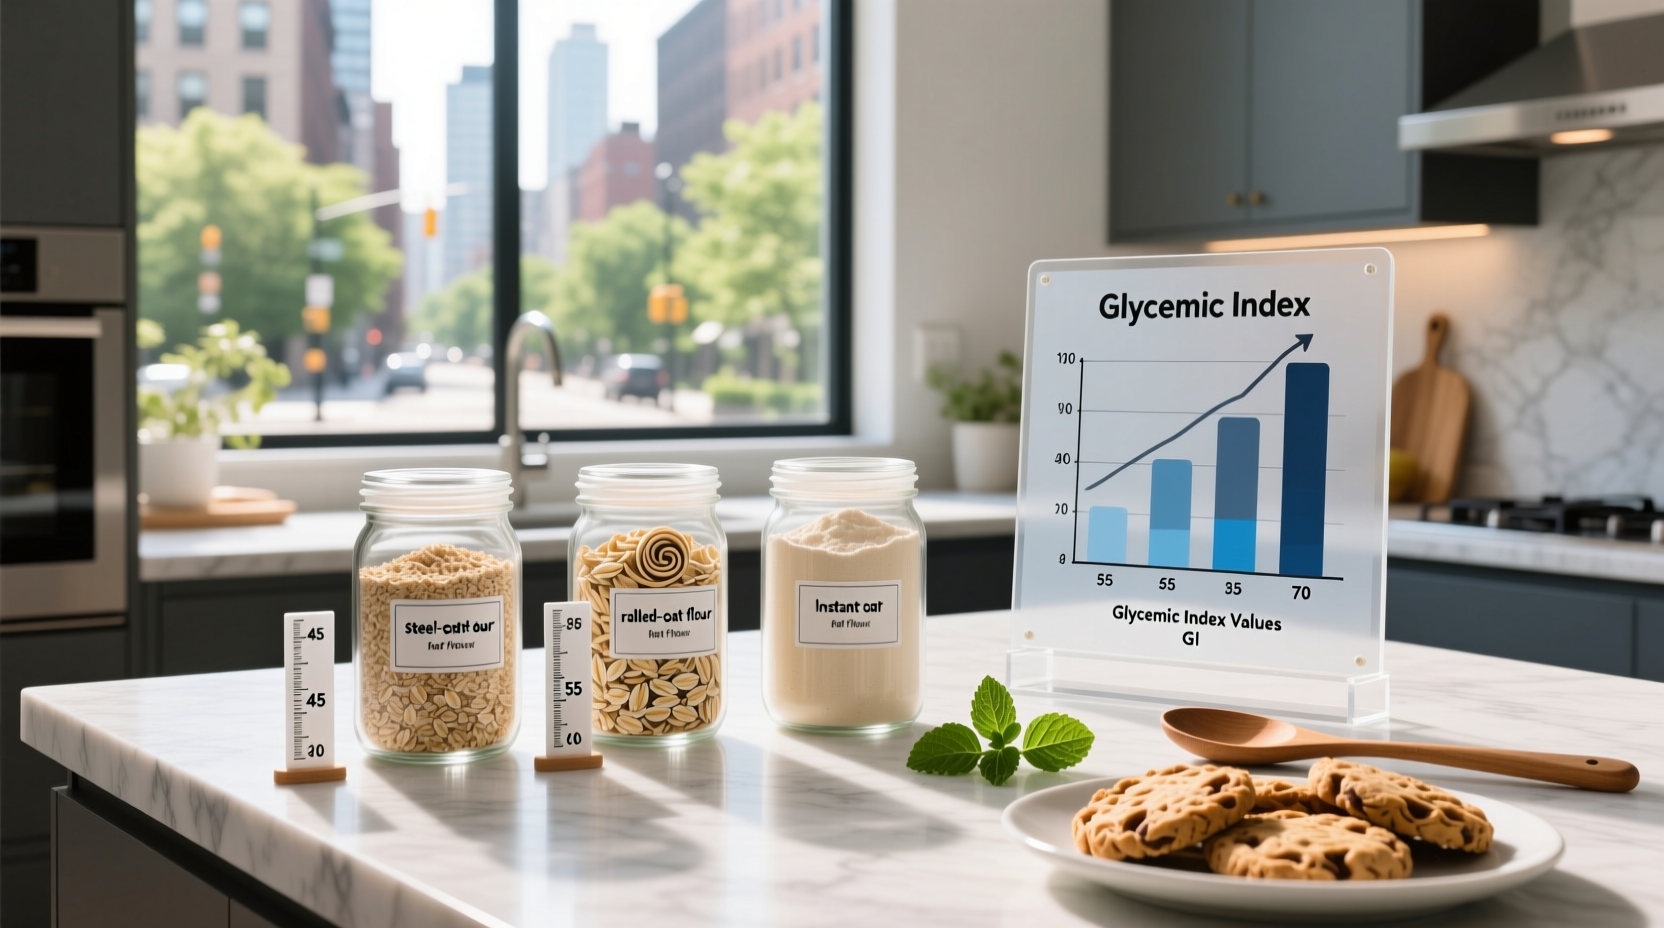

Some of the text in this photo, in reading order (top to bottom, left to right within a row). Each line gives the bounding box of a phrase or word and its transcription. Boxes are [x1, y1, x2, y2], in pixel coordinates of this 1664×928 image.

[1099, 290, 1311, 327] Glycemic Index
[1096, 573, 1114, 587] 55
[1158, 577, 1176, 591] 55
[1225, 581, 1242, 596] 35
[1291, 586, 1311, 600] 70
[815, 598, 861, 613] Instant
[686, 606, 713, 622] flour
[1112, 604, 1282, 632] Glycemic Index Values
[307, 627, 325, 641] 45
[1182, 631, 1200, 647] GI
[565, 681, 583, 697] 55
[306, 692, 326, 708] 45
